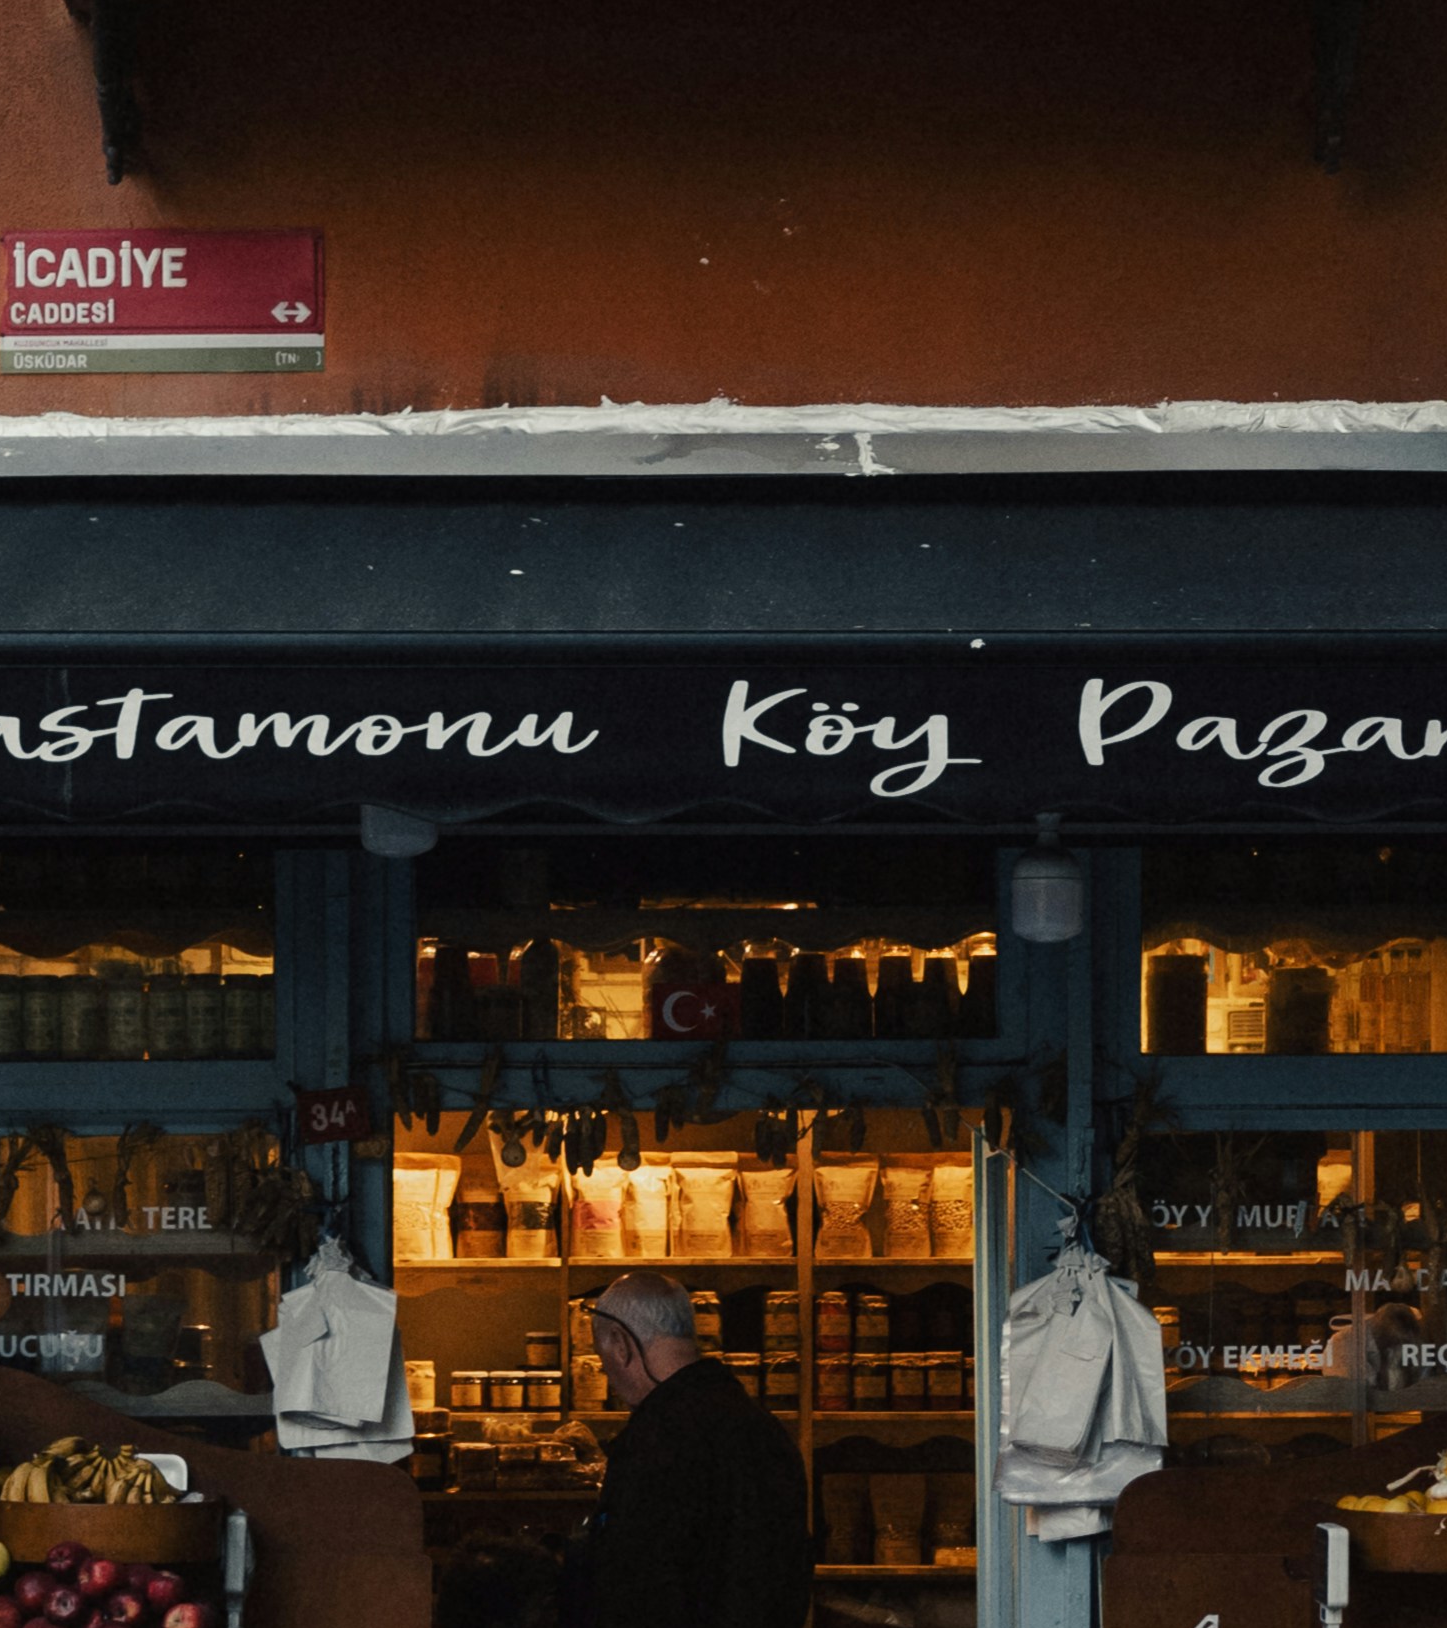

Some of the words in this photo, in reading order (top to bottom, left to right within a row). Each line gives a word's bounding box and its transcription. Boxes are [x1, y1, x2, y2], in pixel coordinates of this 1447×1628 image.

[14, 240, 187, 289] İCADİYE
[10, 298, 115, 325] CADDESİ
[13, 352, 88, 369] ÜSKÜDAR
[722, 679, 983, 798] Köy
[1151, 1199, 1189, 1228] ÖY
[6, 1273, 126, 1298] TIRMASI
